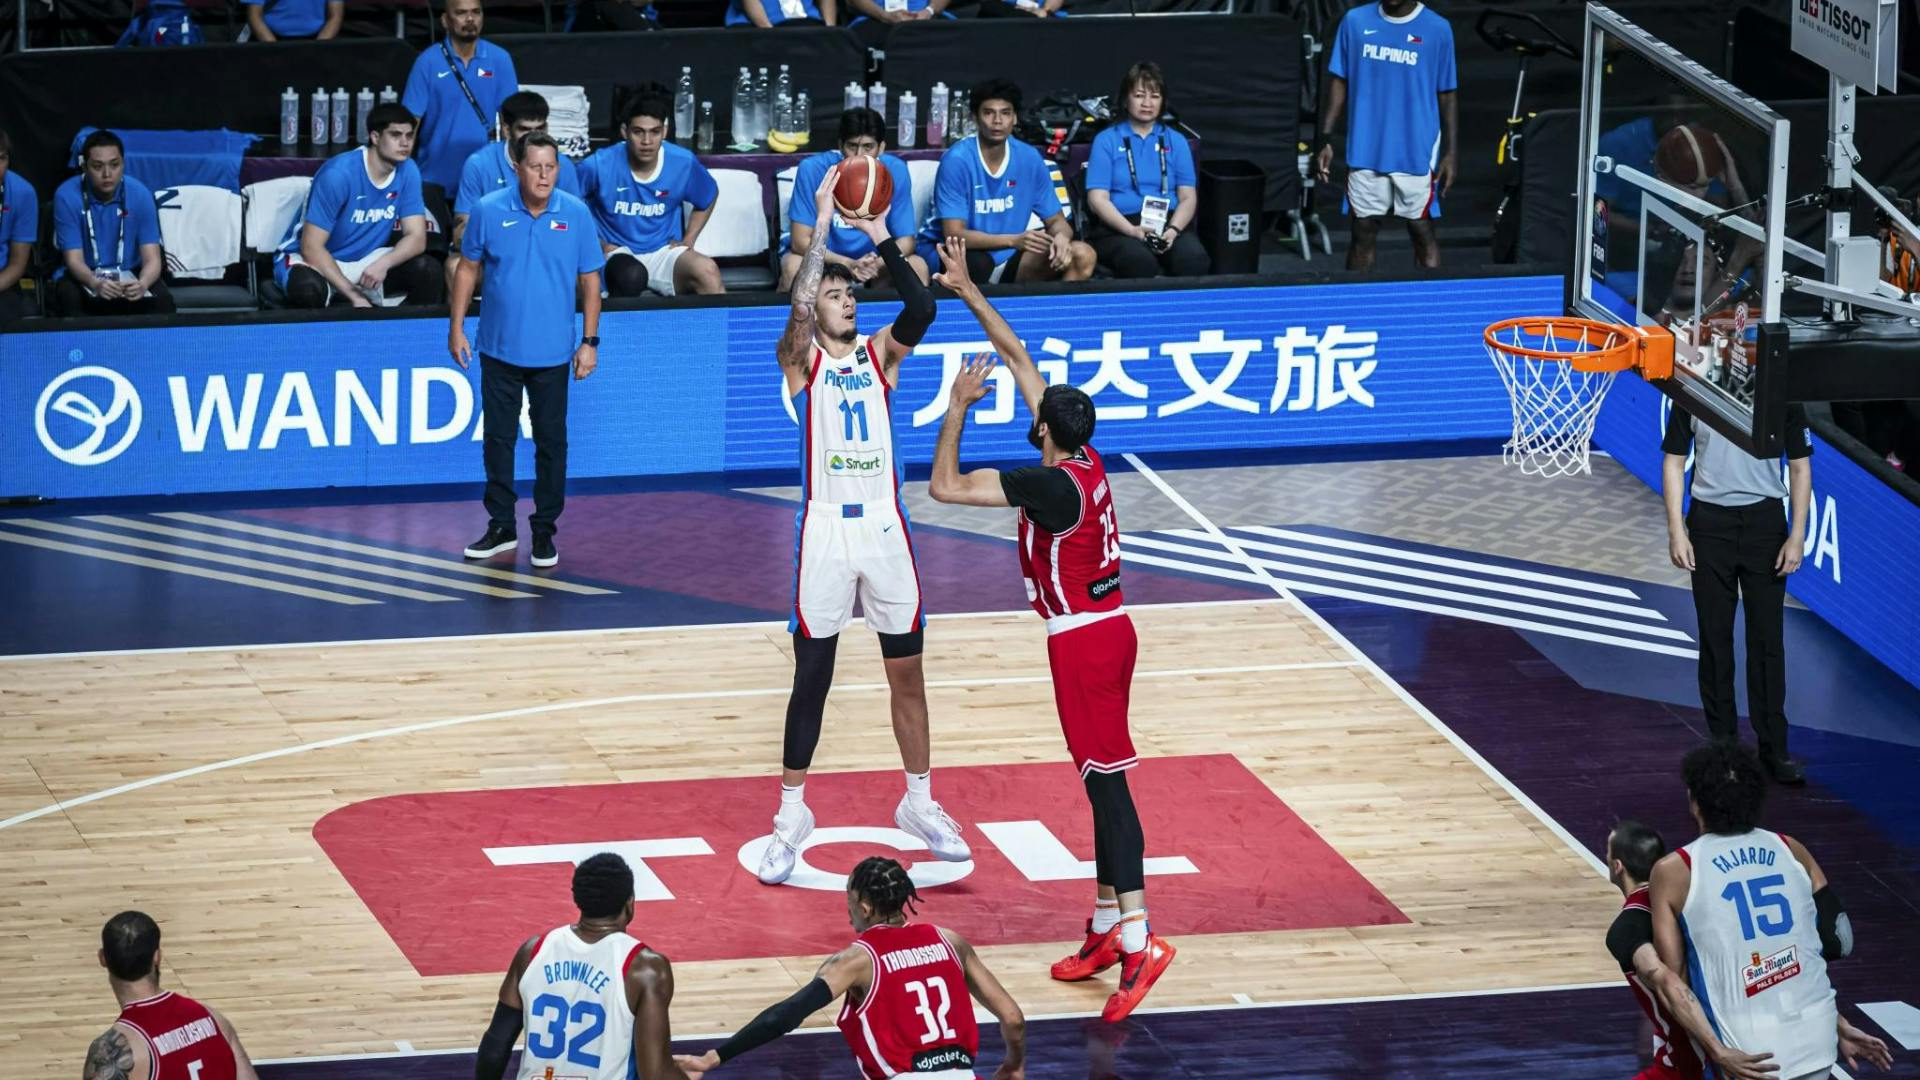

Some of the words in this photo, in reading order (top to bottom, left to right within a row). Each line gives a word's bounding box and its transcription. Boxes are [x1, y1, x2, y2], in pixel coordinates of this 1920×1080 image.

[1821, 0, 1871, 45] TISSOT
[1363, 43, 1418, 66] PILIPINAS
[614, 201, 666, 217] PILIPINAS
[912, 324, 1379, 428] 万达文旅
[838, 400, 869, 442] 11
[845, 456, 880, 470] Smart
[481, 820, 1201, 900] TCL
[1712, 847, 1776, 873] FAJARDO
[1720, 873, 1794, 941] 15
[880, 943, 950, 974] THOMASSON
[1746, 967, 1764, 980] San
[1763, 950, 1794, 973] Miguel
[544, 960, 610, 994] BROWNLEE
[1756, 977, 1774, 991] PALE
[1773, 966, 1798, 982] PILSEN
[904, 976, 957, 1044] 32
[528, 993, 607, 1069] 32
